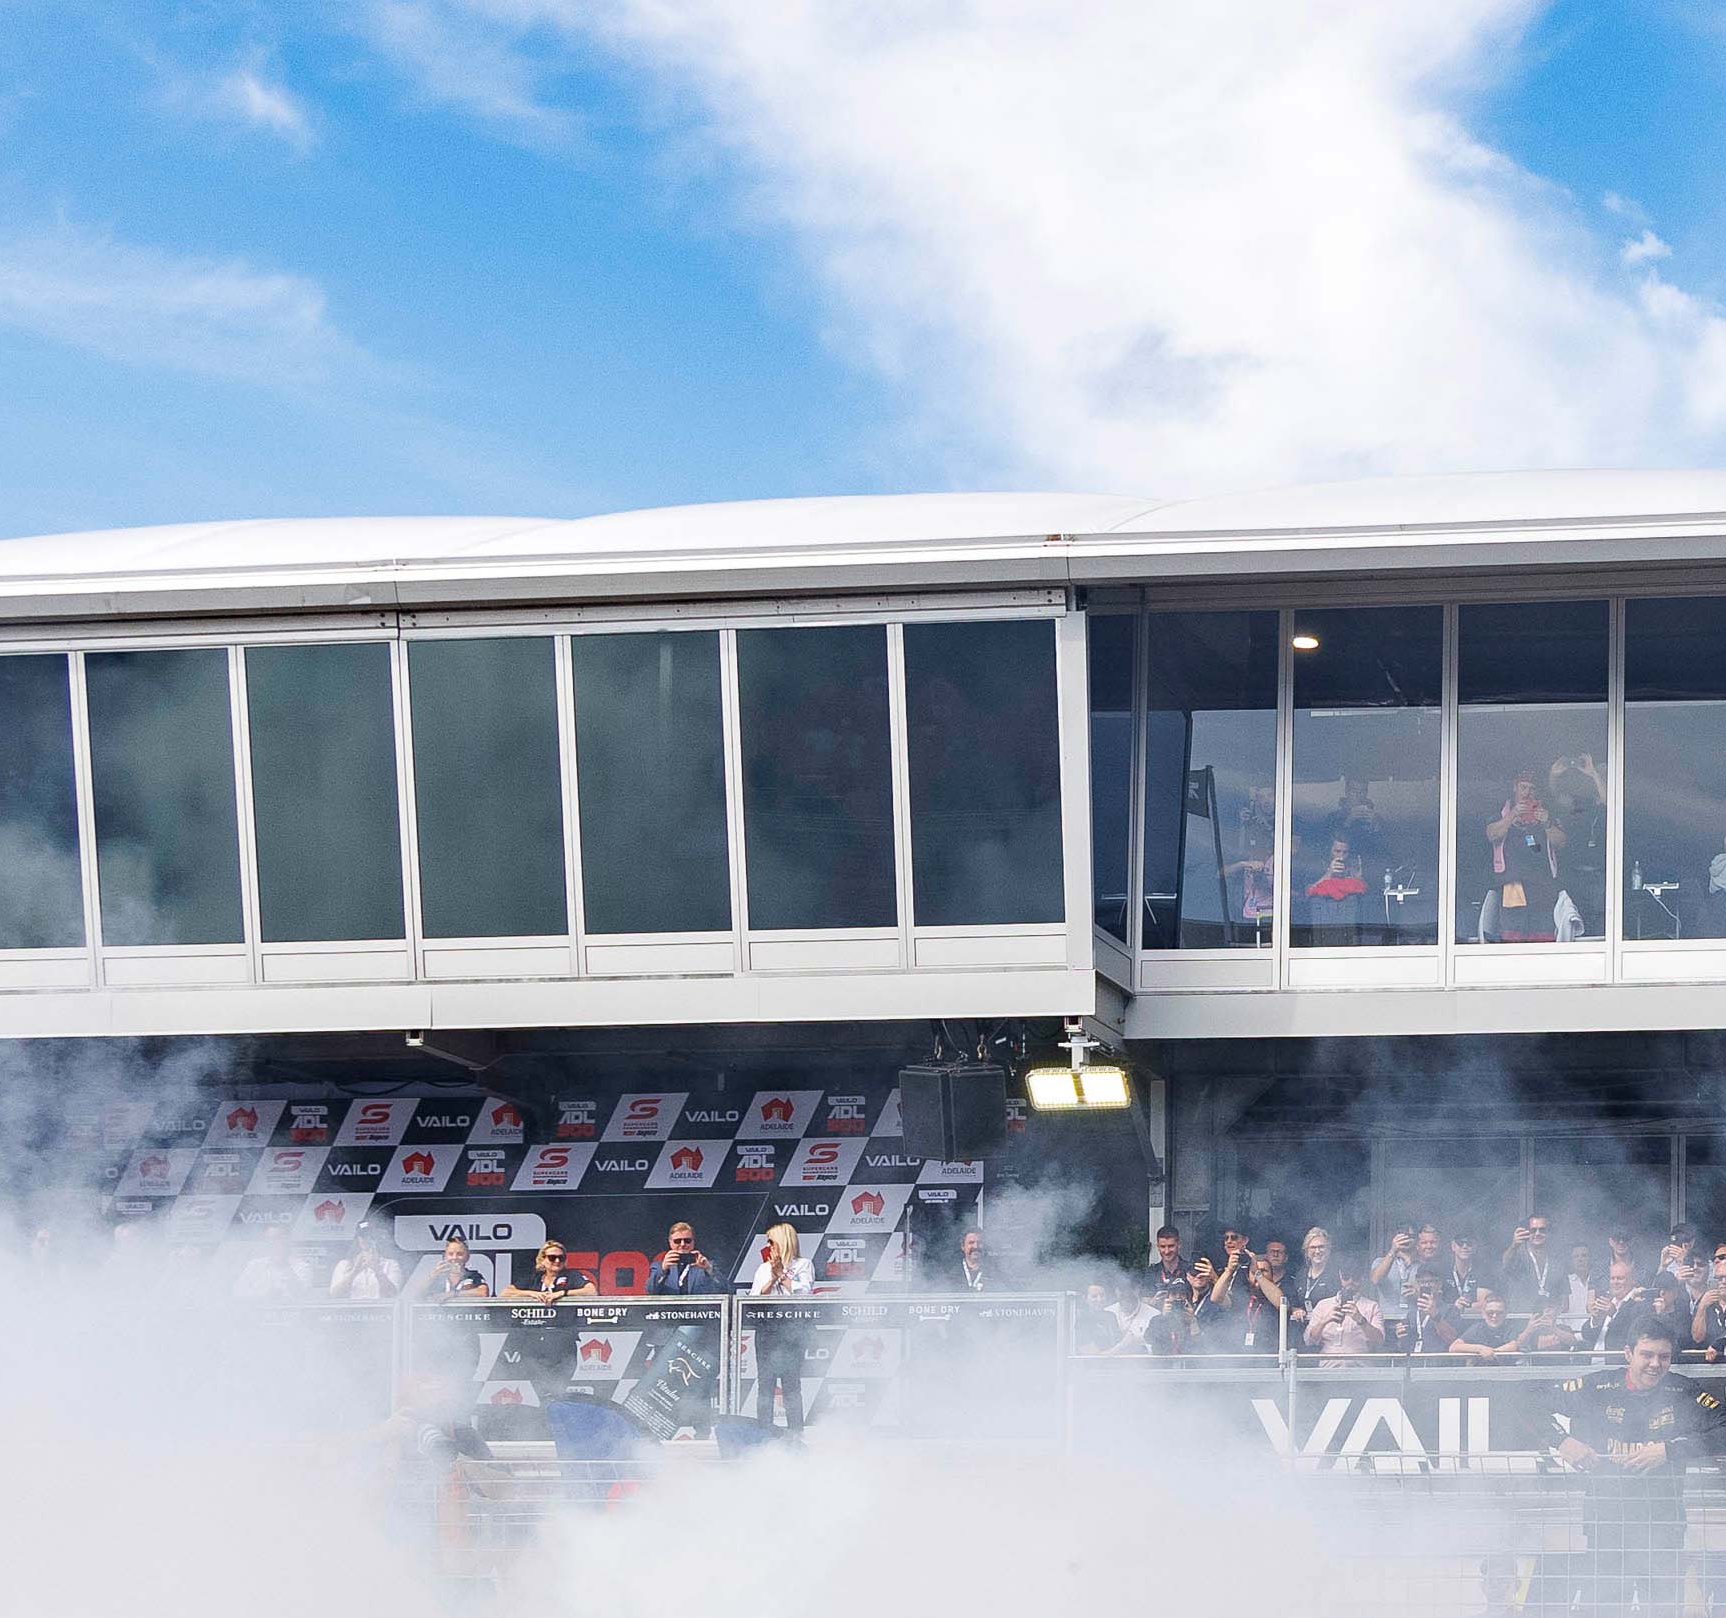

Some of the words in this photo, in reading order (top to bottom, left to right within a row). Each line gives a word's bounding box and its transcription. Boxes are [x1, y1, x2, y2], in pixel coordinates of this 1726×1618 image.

[685, 1110, 739, 1122] VAILO
[828, 1106, 865, 1119] ADL
[292, 1115, 329, 1129] ADL
[417, 1115, 470, 1128] VAILO
[760, 1122, 794, 1131] ADELAIDE
[595, 1159, 649, 1172] VAILO
[736, 1155, 775, 1169] ADL
[865, 1154, 921, 1167] VAILO
[328, 1163, 381, 1176] VAILO
[468, 1161, 505, 1174] ADL
[941, 1167, 977, 1175] ADELAIDE
[401, 1176, 435, 1185] ADELAIDE
[669, 1171, 704, 1180] ADELAIDE
[774, 1203, 829, 1217] VAILO
[239, 1211, 293, 1224] VAILO
[850, 1216, 885, 1225] ADELAIDE
[429, 1223, 513, 1242] VAILO
[566, 1251, 671, 1297] 50
[511, 1308, 557, 1320] SCHILD
[577, 1308, 606, 1317] BONE
[608, 1307, 628, 1317] DRY
[660, 1311, 721, 1320] STONEHAVEN
[757, 1310, 821, 1319] RESCHKE
[841, 1305, 888, 1317] SCHILD
[909, 1305, 937, 1315] BONE
[940, 1305, 961, 1315] DRY
[1251, 1397, 1573, 1474] VAIL
